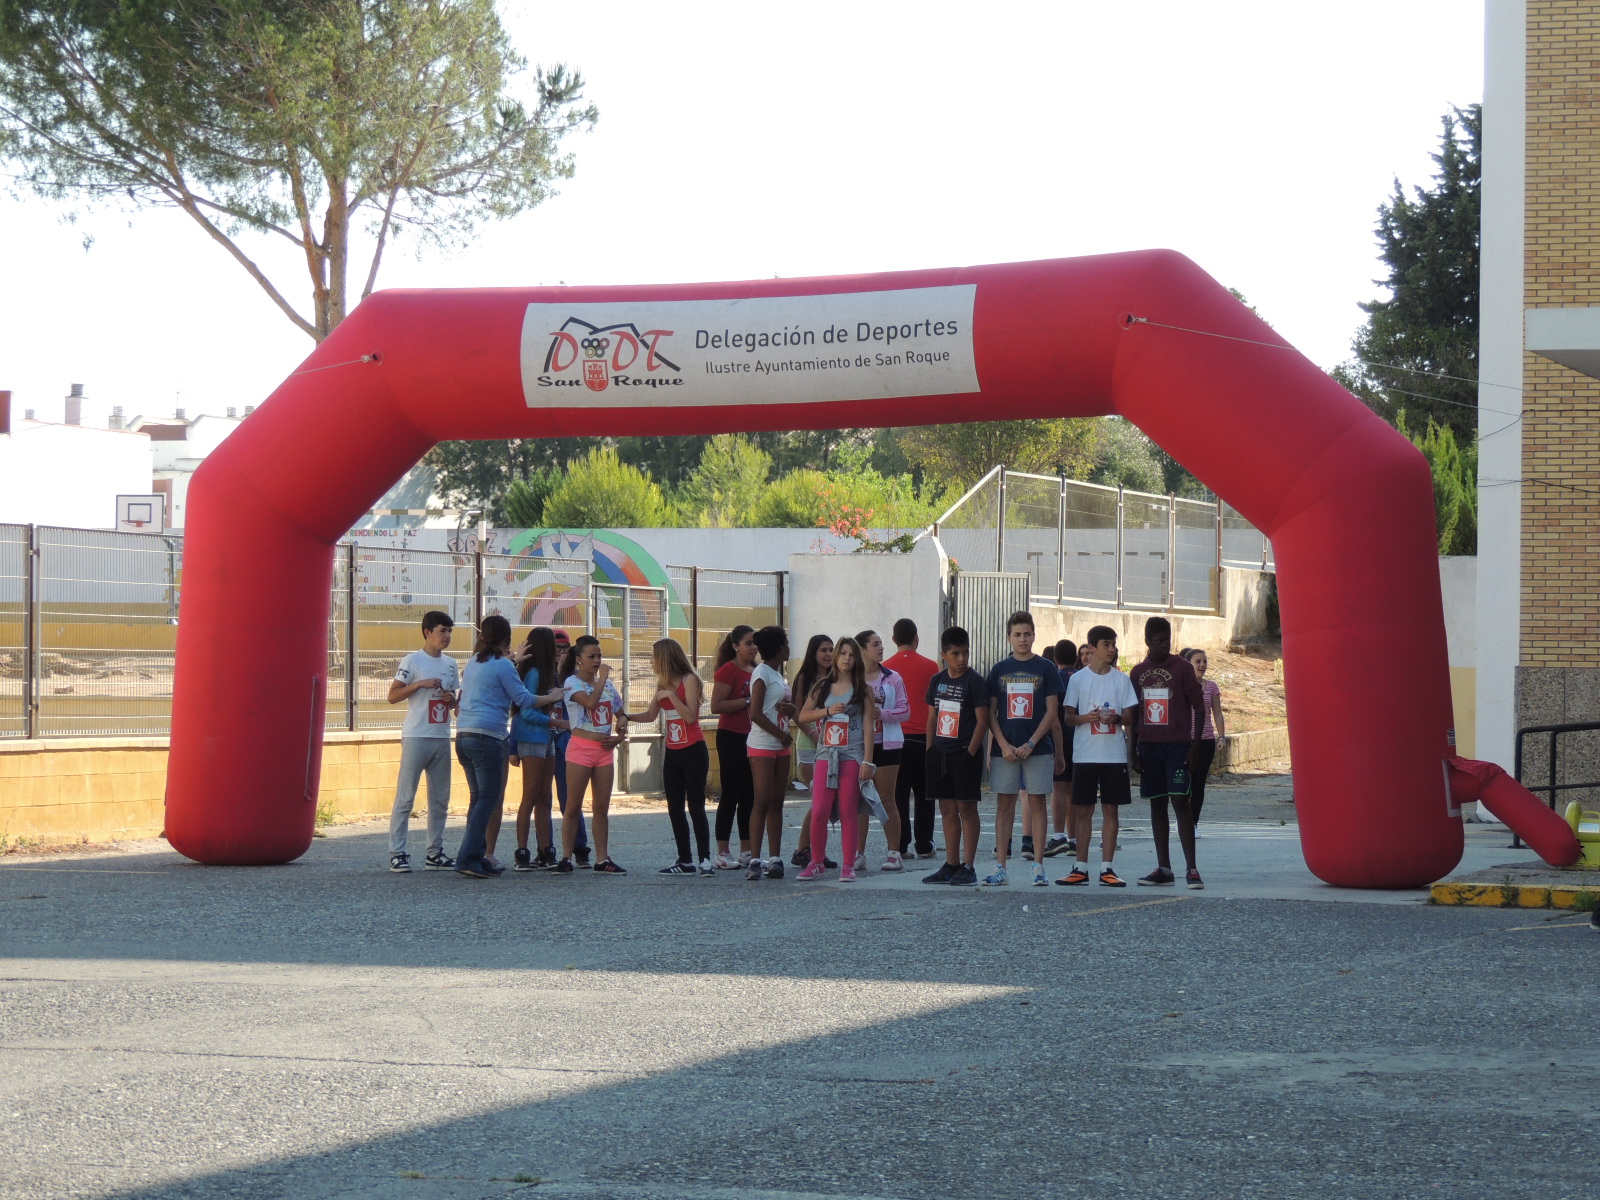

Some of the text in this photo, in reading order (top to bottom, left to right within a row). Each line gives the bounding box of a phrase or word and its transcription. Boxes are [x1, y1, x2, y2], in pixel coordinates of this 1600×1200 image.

[695, 319, 958, 353] Delegación de Deportes
[705, 350, 950, 376] Ilustre Ayuntamiento de San Roque
[537, 375, 685, 389] San Roque
